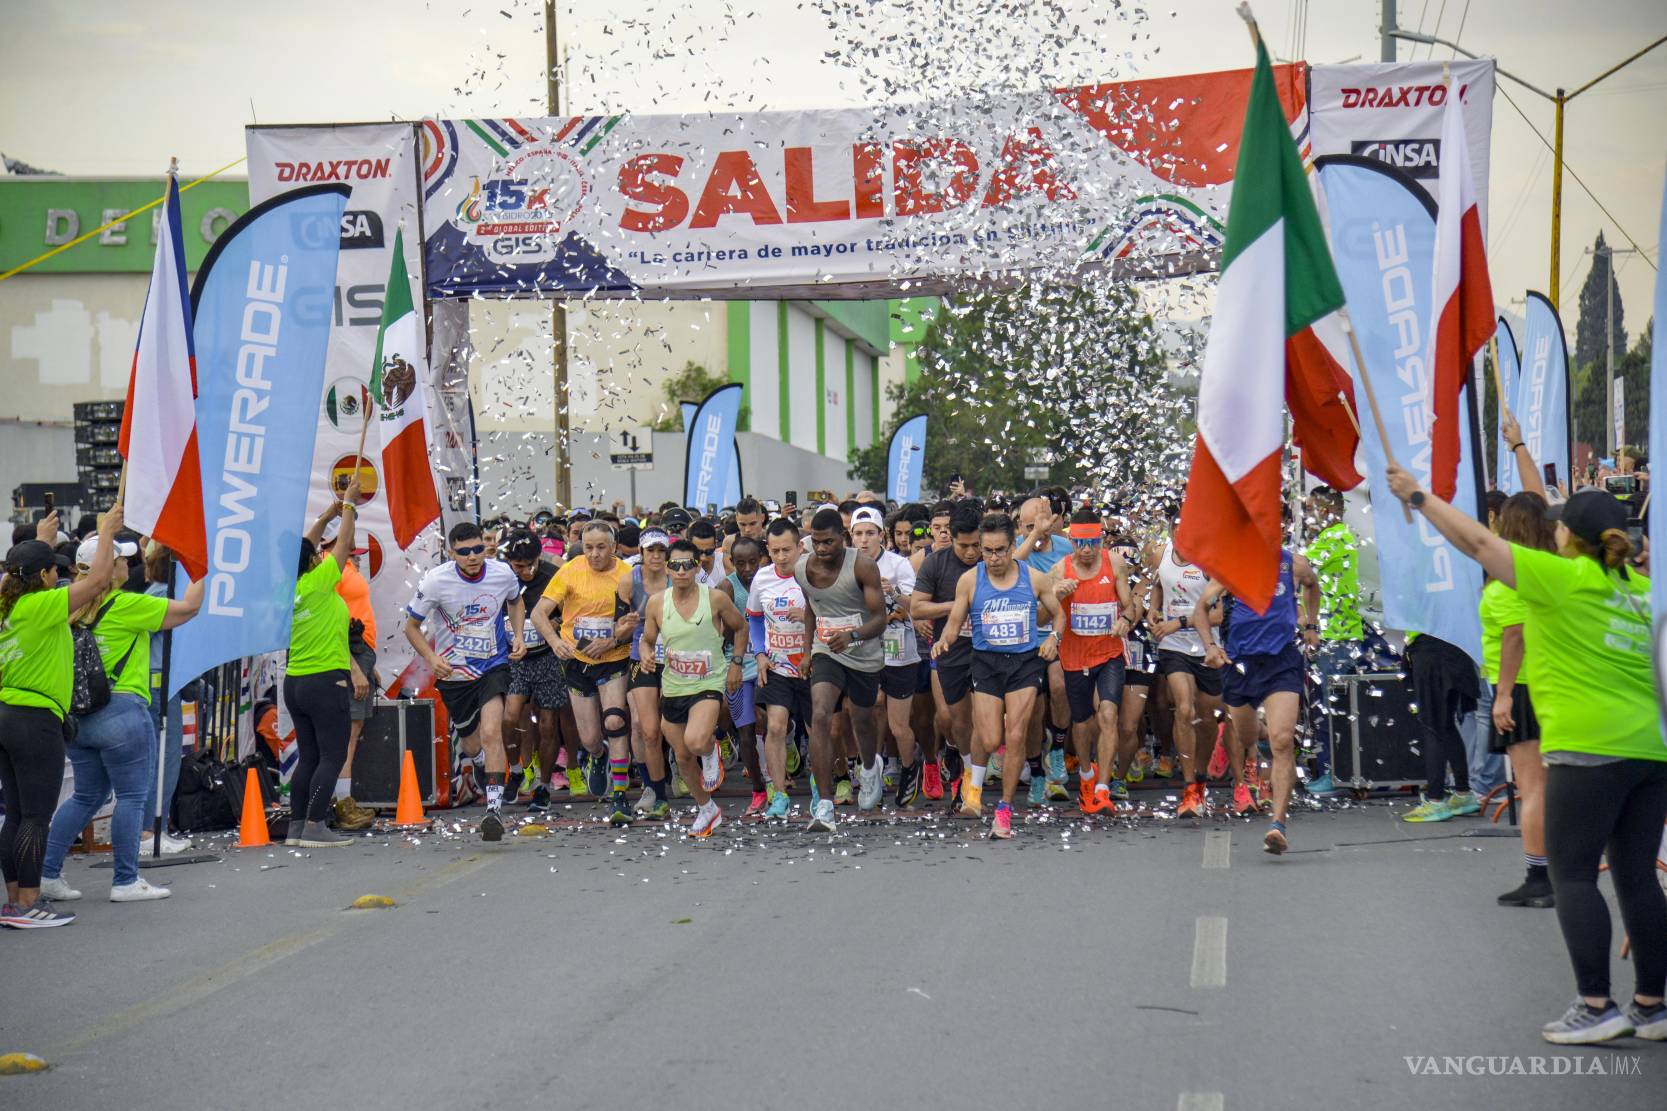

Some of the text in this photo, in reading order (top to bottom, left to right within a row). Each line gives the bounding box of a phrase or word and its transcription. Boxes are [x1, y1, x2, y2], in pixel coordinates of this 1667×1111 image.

[275, 158, 393, 182] DRAXTON
[616, 126, 1080, 233] SALIDA
[482, 179, 551, 212] 15K
[494, 224, 522, 233] GLOBAL
[492, 236, 542, 255] GIS
[672, 247, 749, 263] carrera
[757, 244, 783, 259] de
[791, 241, 858, 258] mayor
[207, 261, 288, 617] POWERADE
[464, 603, 488, 616] 15K
[774, 596, 795, 608] 15K
[989, 623, 1017, 638] 483
[1075, 615, 1107, 629] 1142
[455, 636, 491, 653] 2420
[770, 632, 804, 649] 4094
